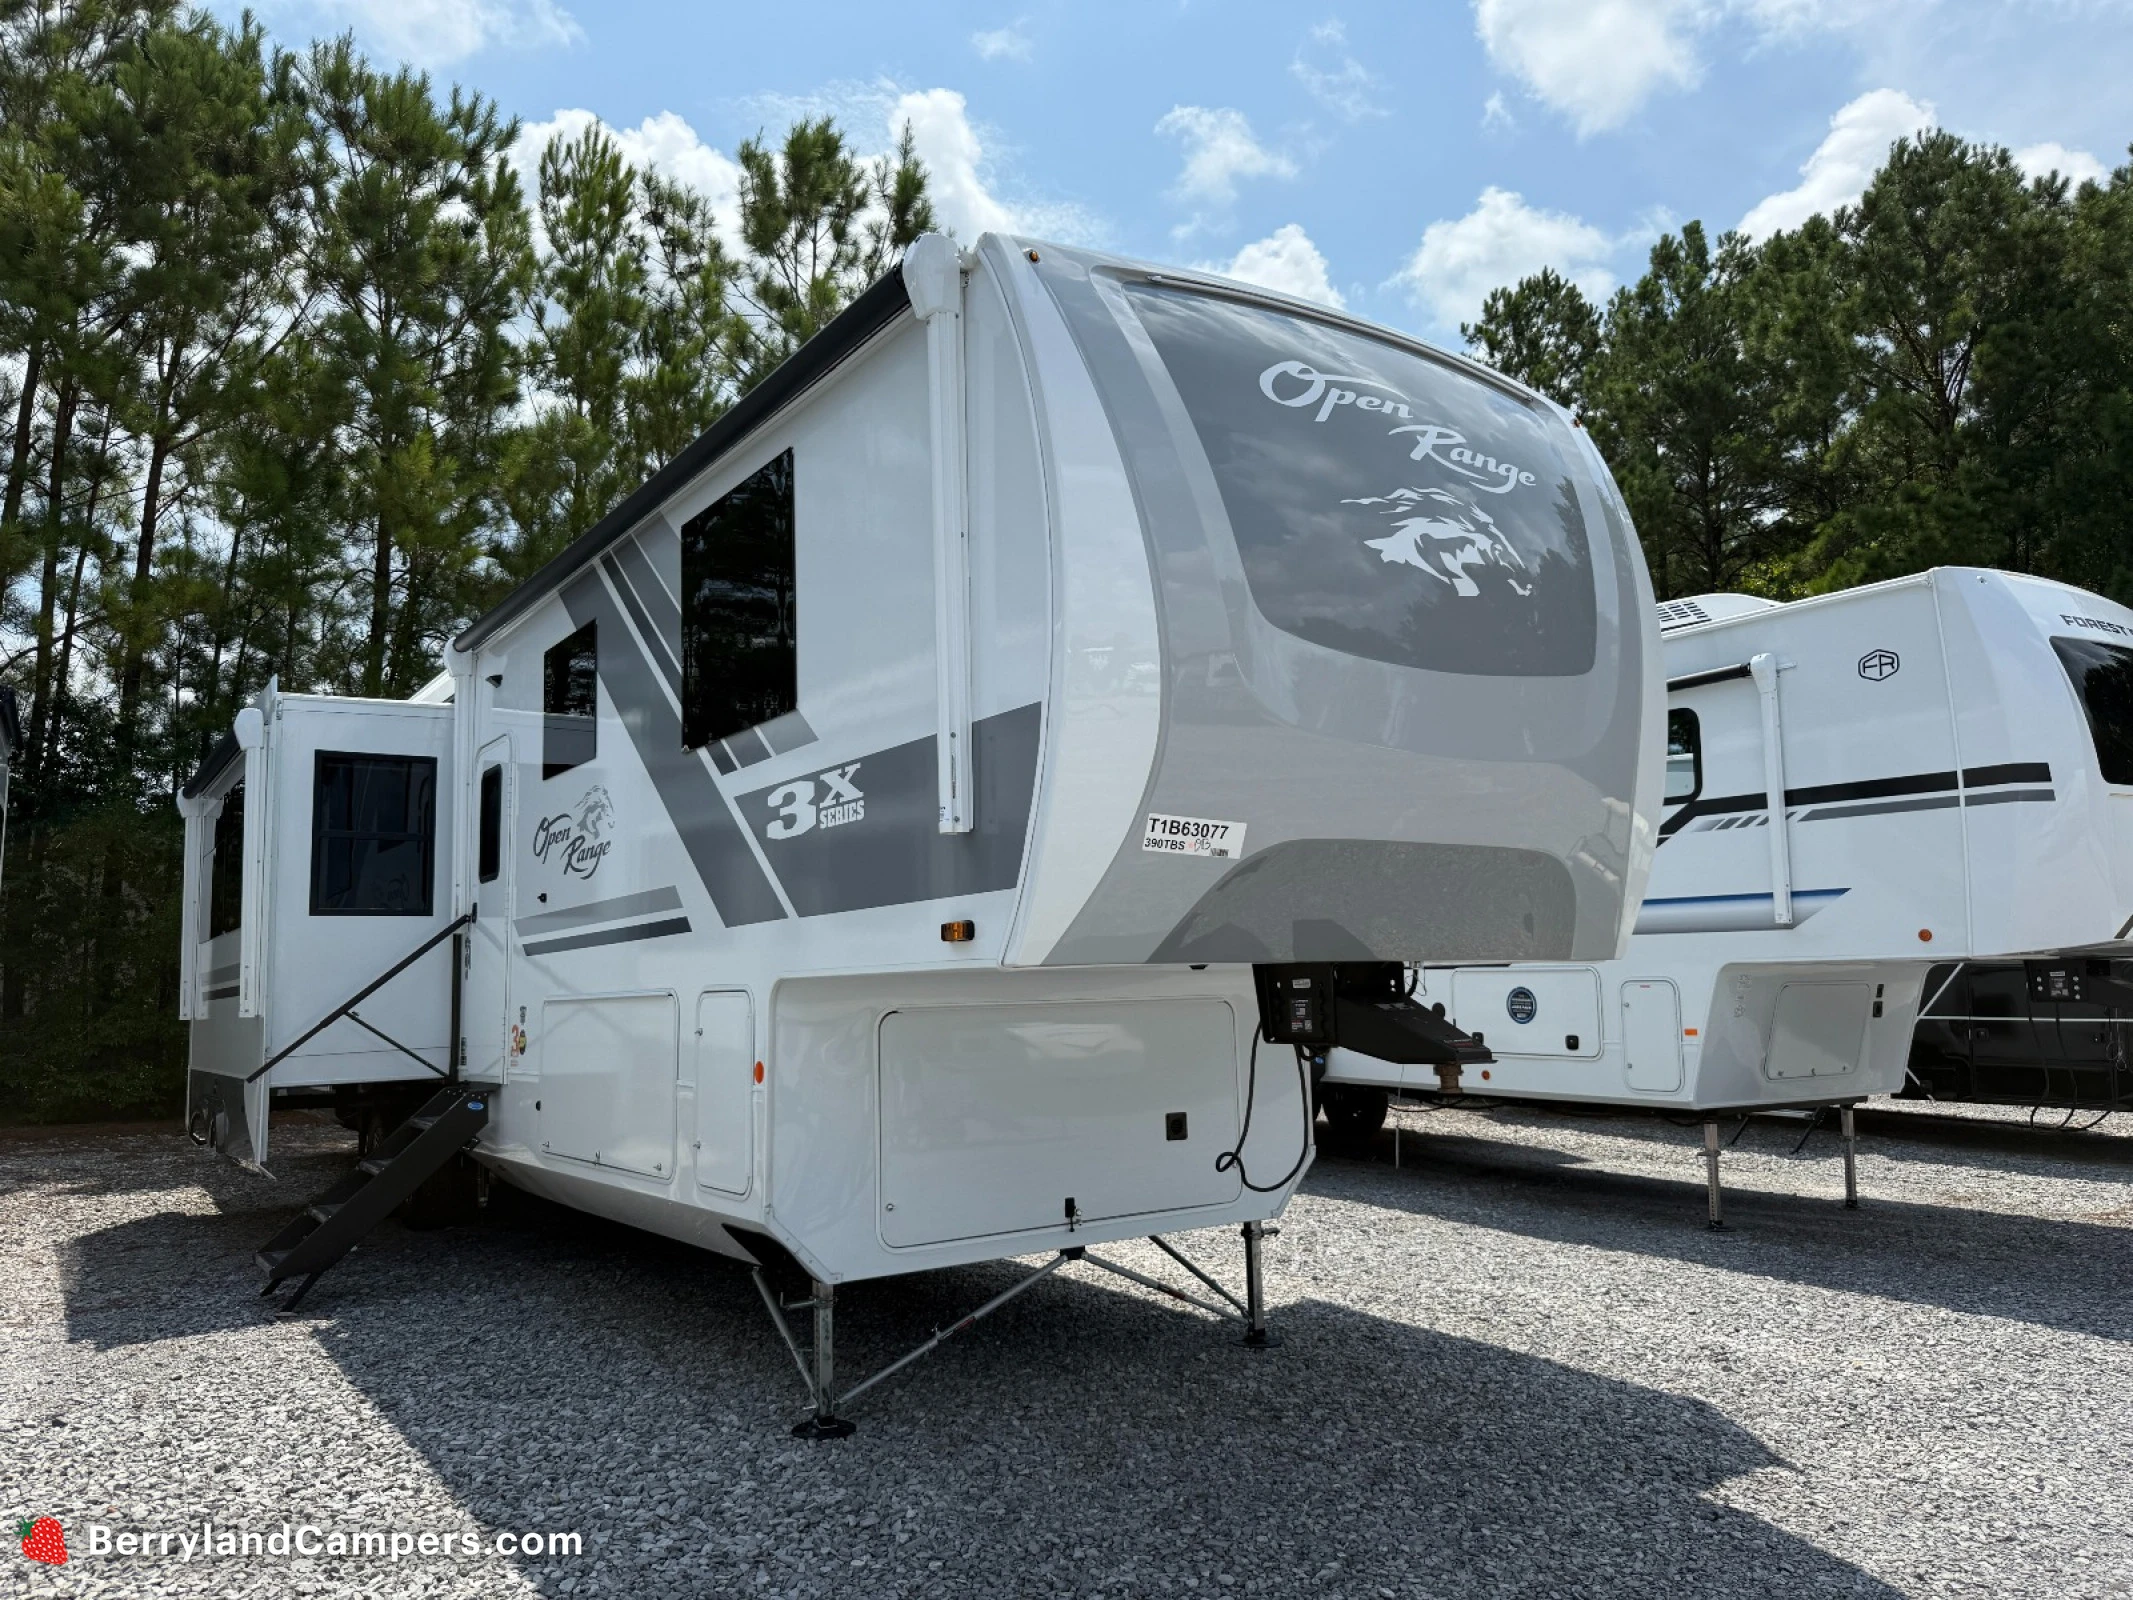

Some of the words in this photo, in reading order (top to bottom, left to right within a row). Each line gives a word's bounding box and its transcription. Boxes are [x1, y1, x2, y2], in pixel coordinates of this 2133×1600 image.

[1259, 360, 1413, 422] Open
[1388, 425, 1536, 493] Range
[2059, 613, 2129, 636] FOREST
[819, 800, 865, 829] SERIES
[1149, 818, 1229, 839] T1B63077
[533, 813, 572, 864] Open
[1144, 838, 1186, 850] 390TBS
[560, 835, 611, 880] Range
